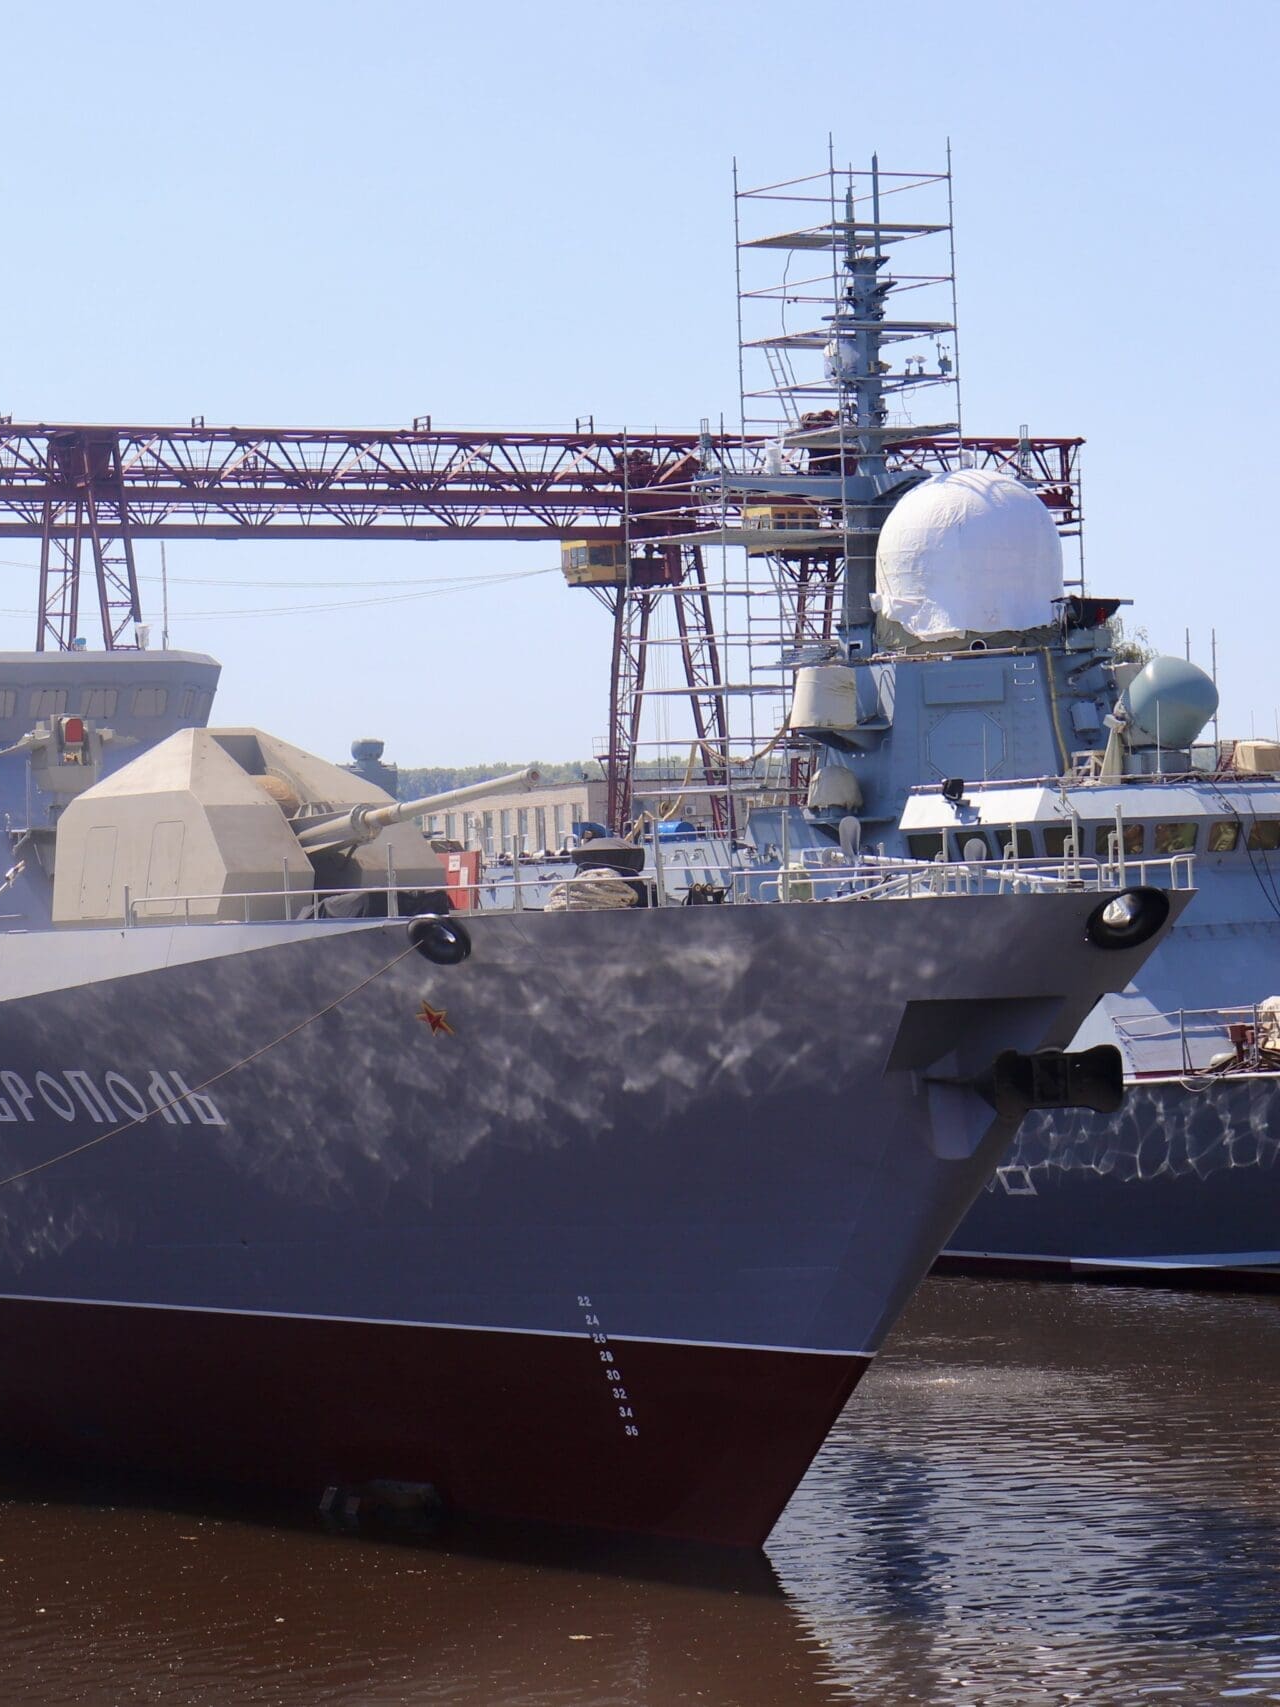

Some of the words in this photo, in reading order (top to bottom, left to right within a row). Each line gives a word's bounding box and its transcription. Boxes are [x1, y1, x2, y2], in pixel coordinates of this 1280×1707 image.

[577, 1296, 592, 1307] 22
[585, 1315, 599, 1326] 24
[593, 1333, 607, 1344] 26
[600, 1351, 614, 1362] 28
[606, 1370, 620, 1380] 30
[612, 1388, 627, 1399] 32
[619, 1406, 633, 1418] 34
[625, 1425, 639, 1436] 36
